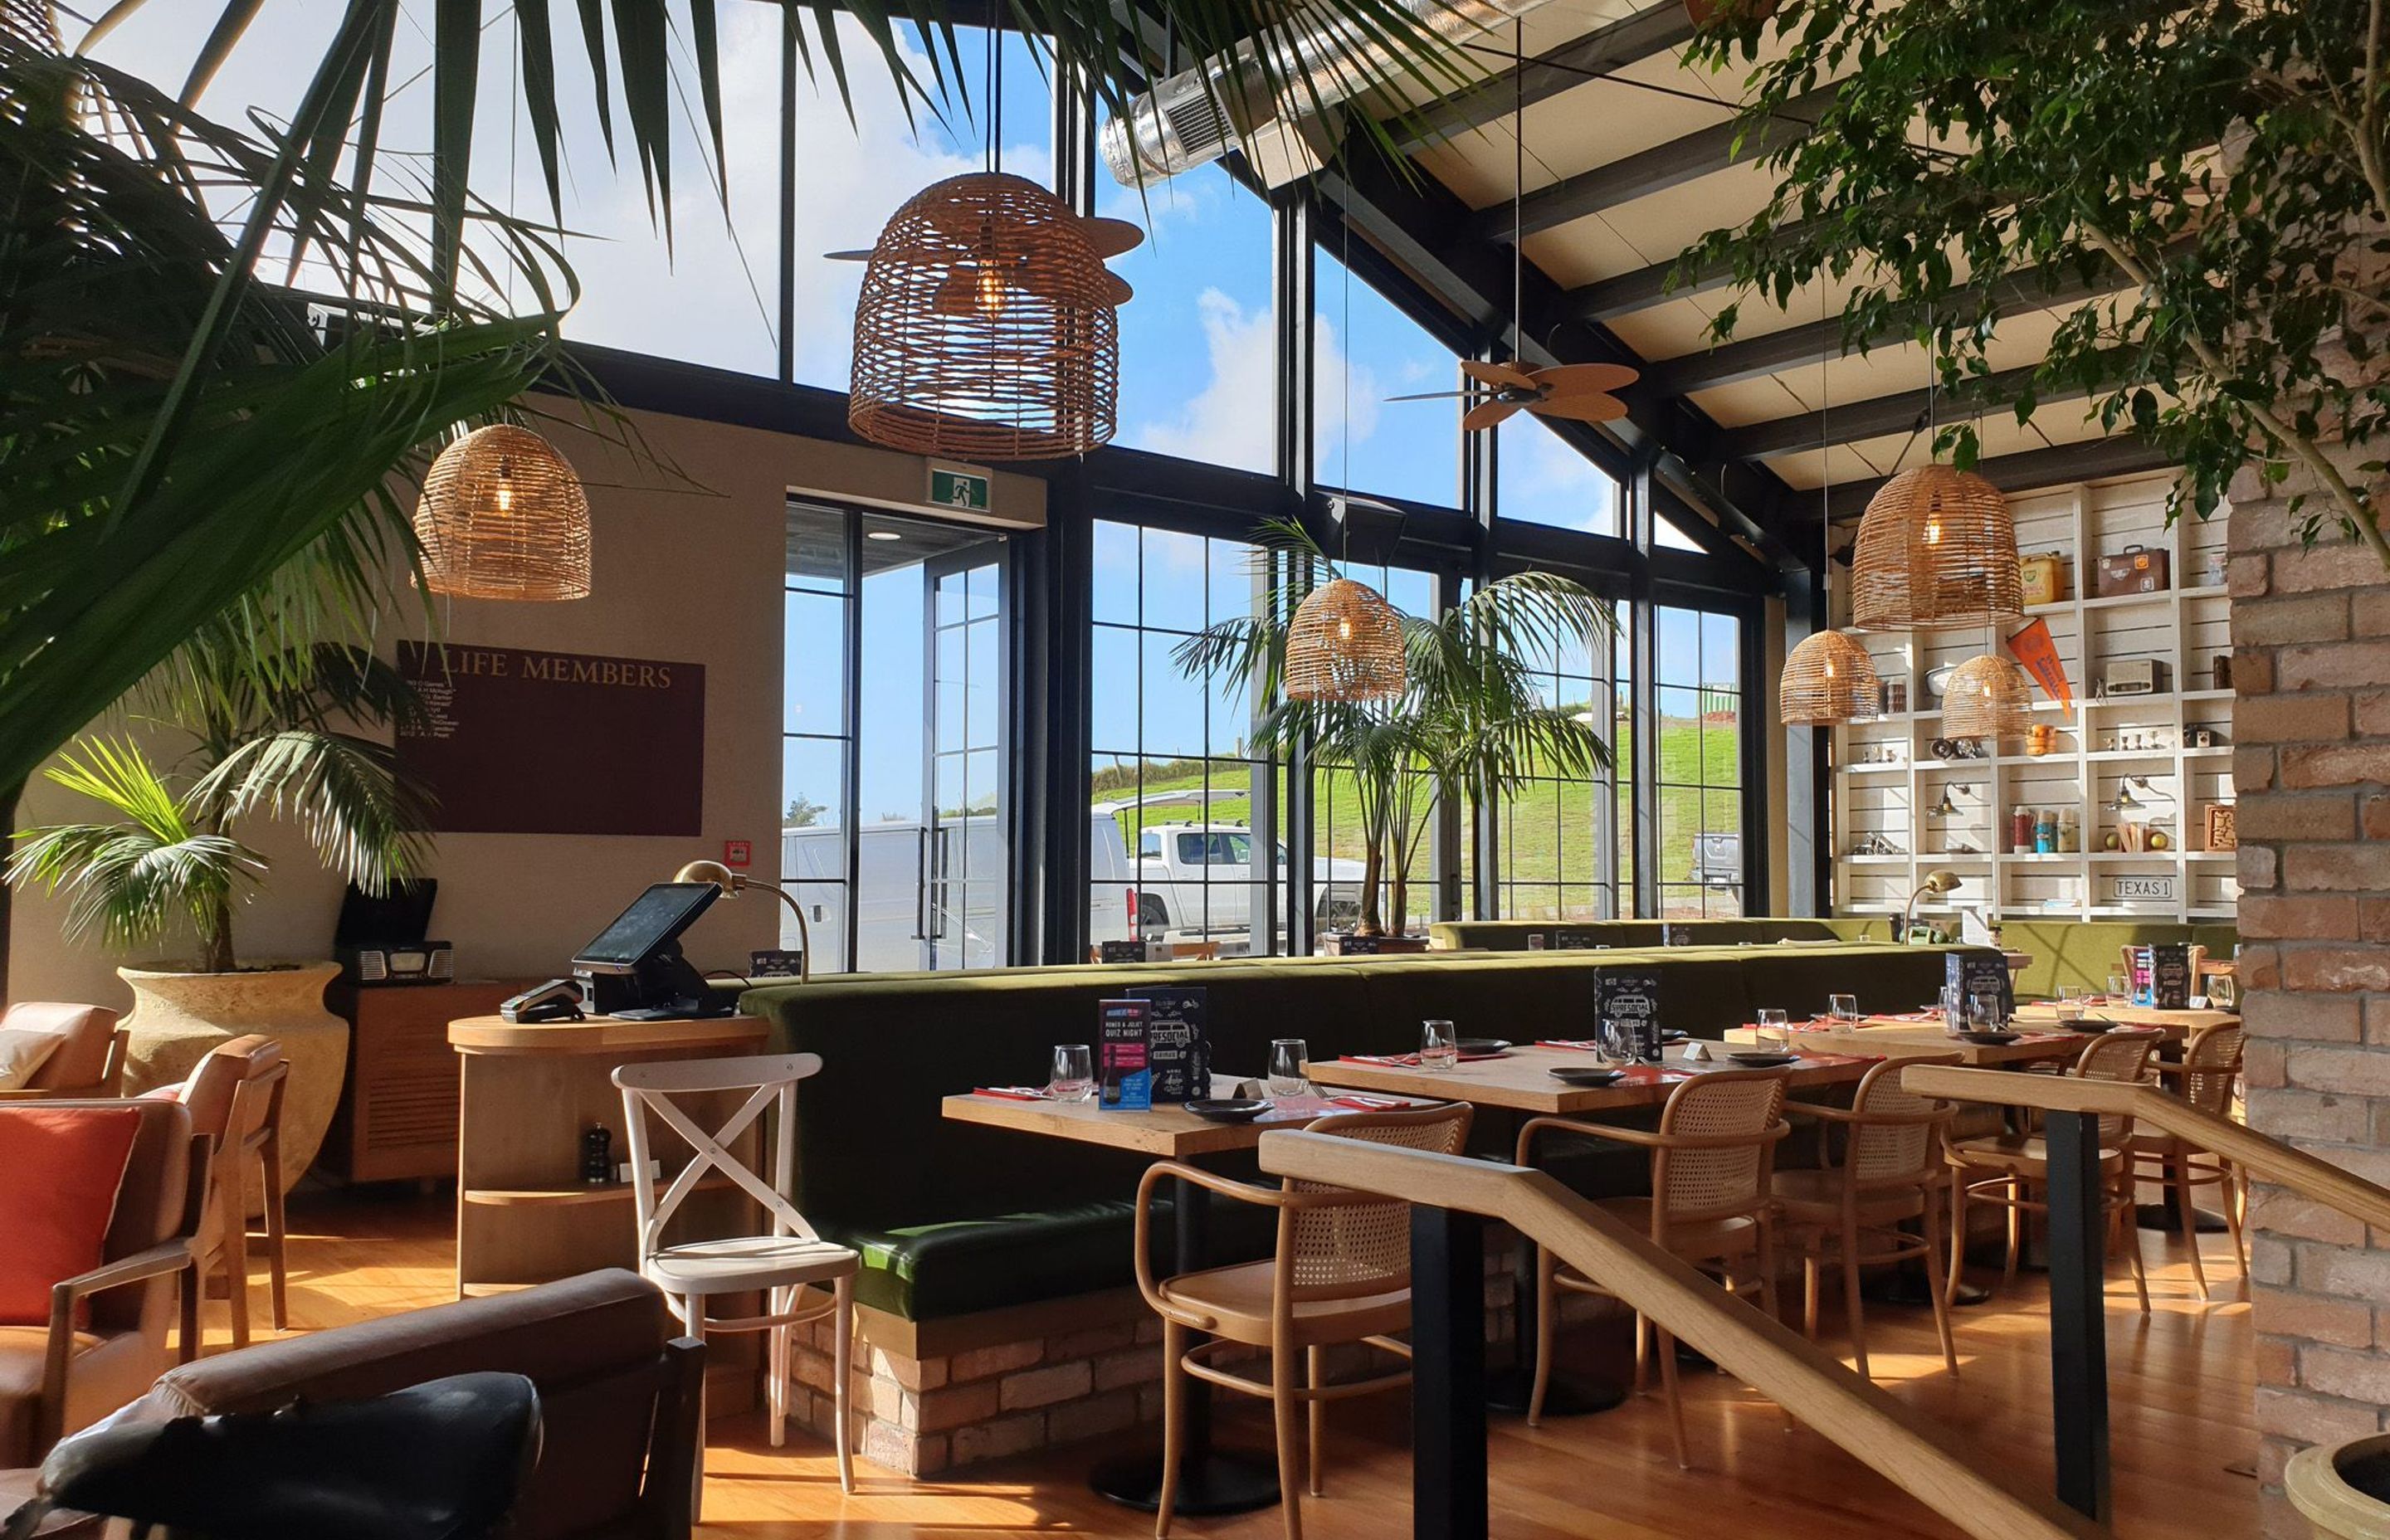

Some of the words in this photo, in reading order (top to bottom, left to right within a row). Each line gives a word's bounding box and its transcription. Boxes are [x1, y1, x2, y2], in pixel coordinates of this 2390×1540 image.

[440, 650, 508, 677] LIFE
[521, 656, 671, 689] MEMBERS
[2116, 881, 2159, 895] TEXAS
[2163, 882, 2168, 895] 1
[1105, 1028, 1121, 1037] QUIZ
[1123, 1028, 1143, 1037] NIGHT
